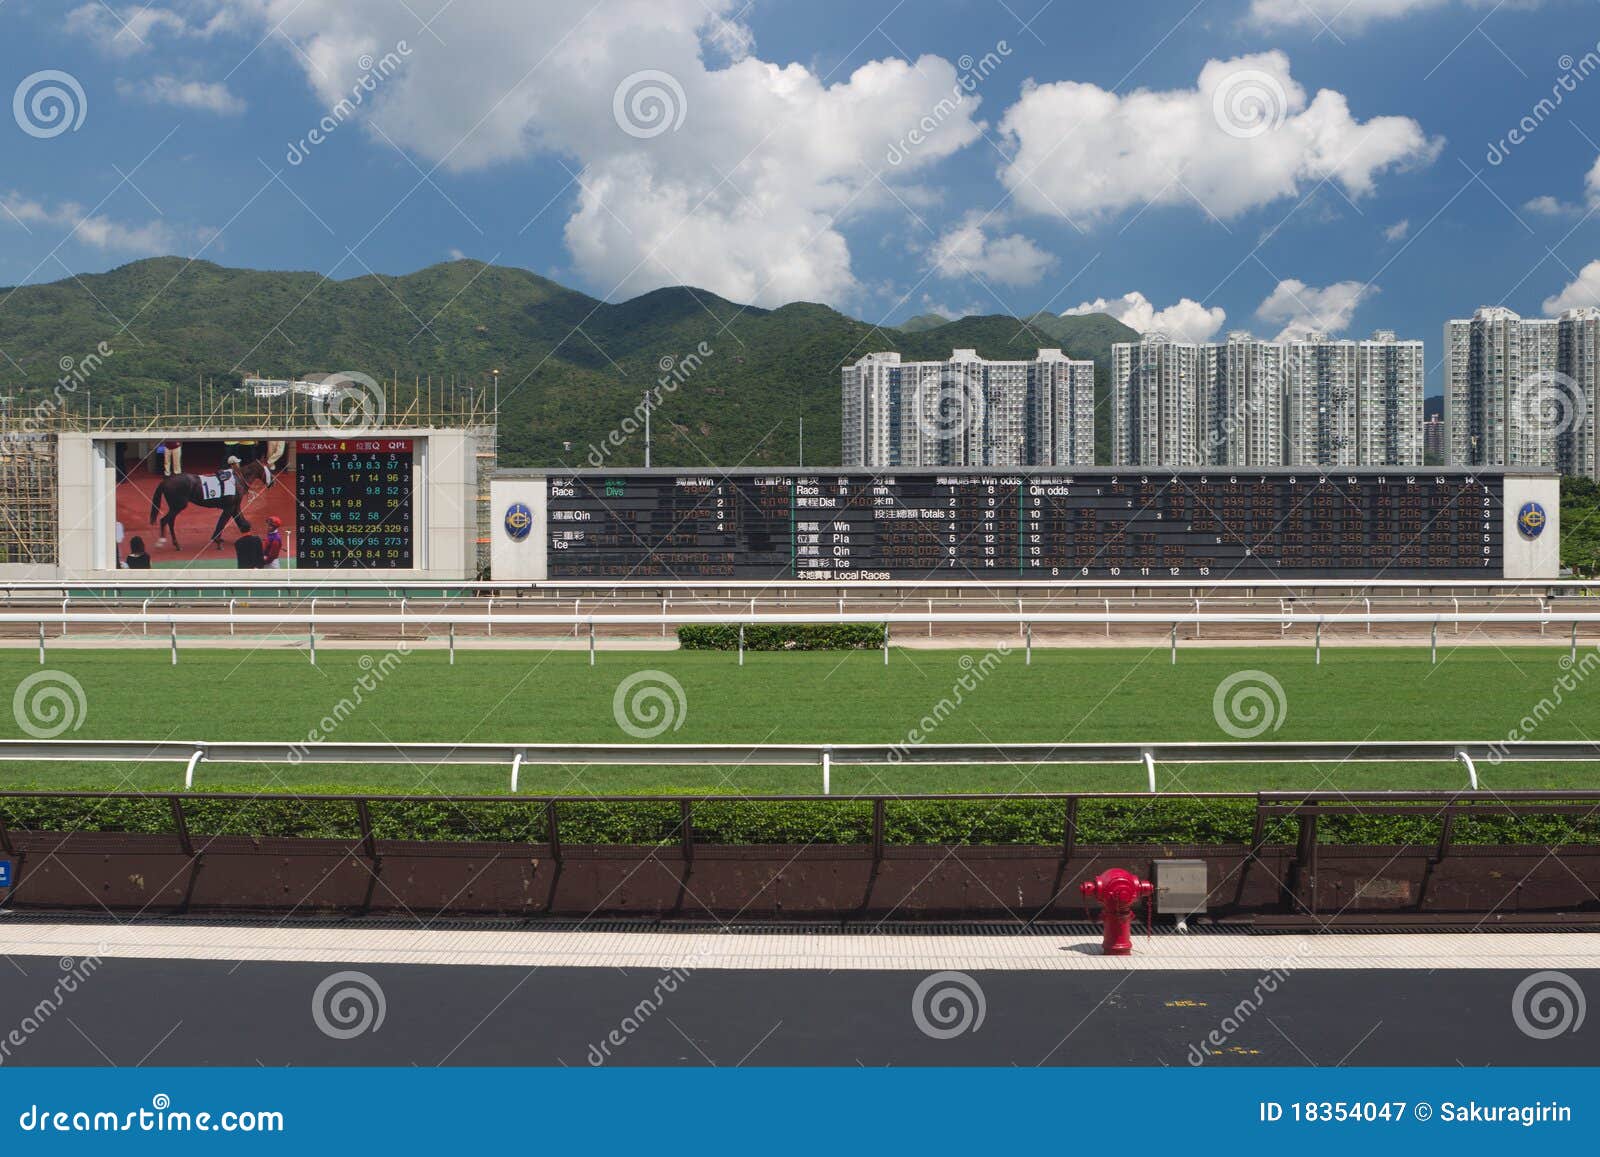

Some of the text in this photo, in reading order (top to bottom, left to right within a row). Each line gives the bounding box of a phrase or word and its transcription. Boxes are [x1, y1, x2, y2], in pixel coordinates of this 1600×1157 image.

[340, 442, 346, 451] 4
[552, 487, 574, 496] Race
[606, 487, 624, 496] Divs
[797, 486, 888, 495] Race in min
[1030, 486, 1069, 495] Qin odds
[717, 499, 724, 507] 2
[920, 509, 945, 518] Totals
[834, 522, 850, 531] Win
[833, 534, 850, 543] Pla
[552, 540, 568, 549] Tce
[833, 546, 850, 555] Qin
[833, 559, 850, 568] Tce
[834, 570, 859, 580] Local
[860, 570, 890, 579] Races
